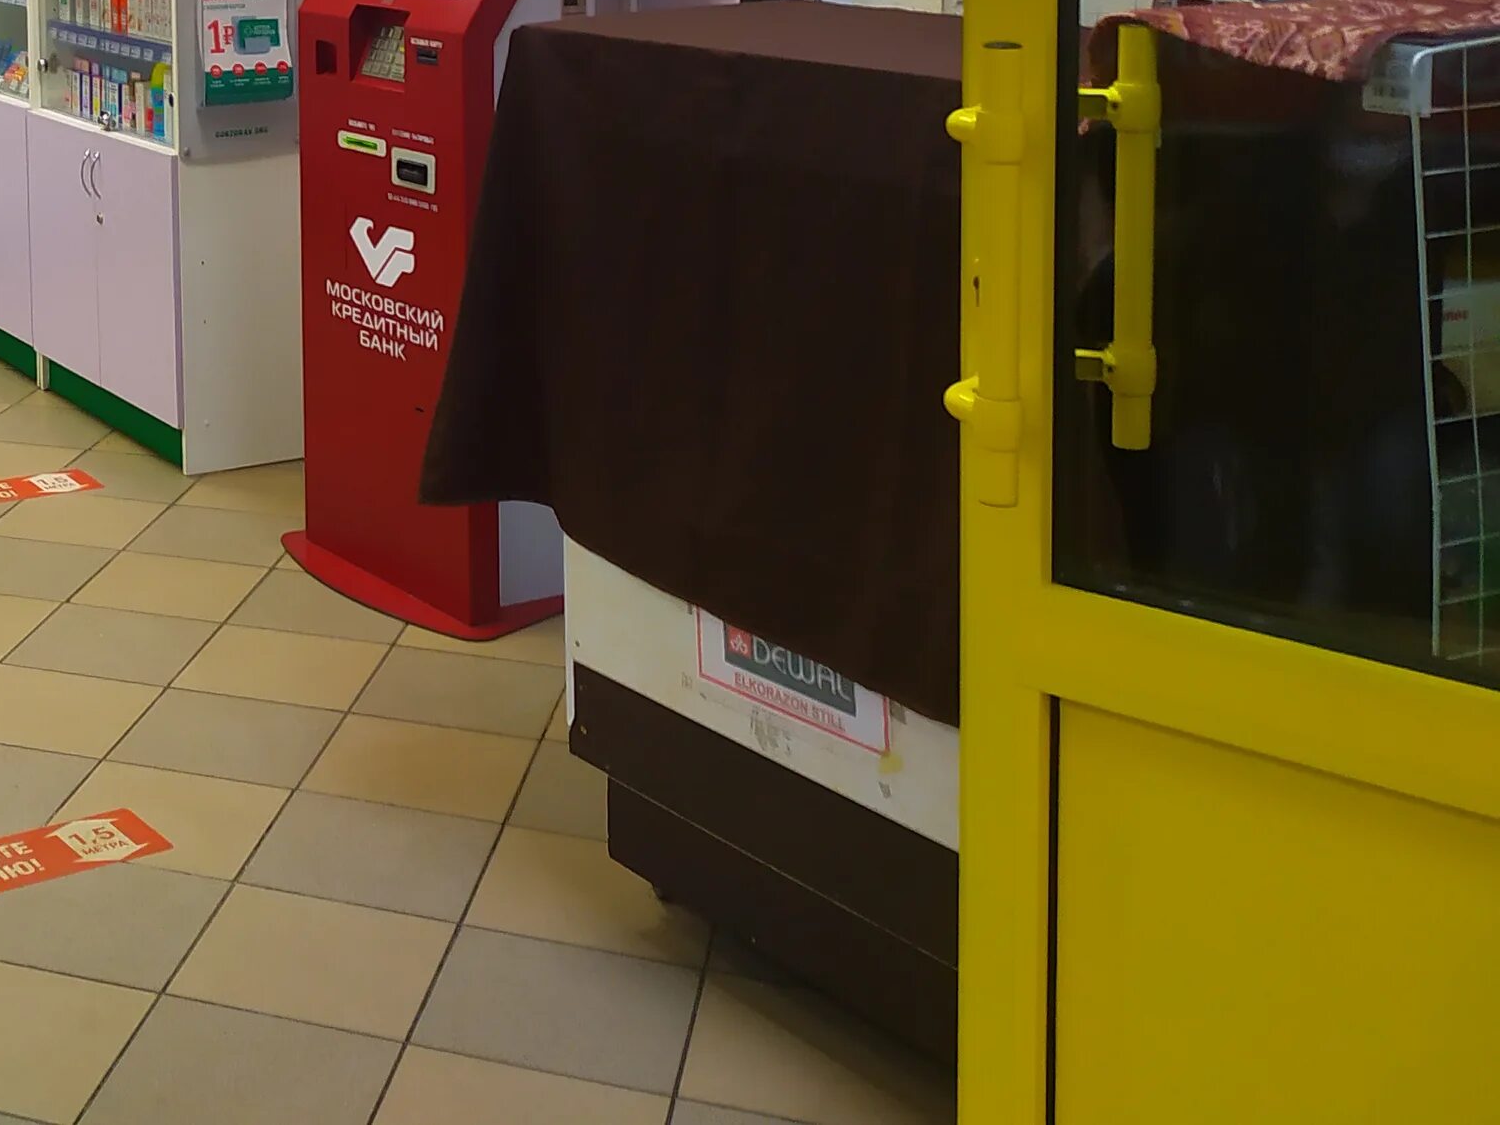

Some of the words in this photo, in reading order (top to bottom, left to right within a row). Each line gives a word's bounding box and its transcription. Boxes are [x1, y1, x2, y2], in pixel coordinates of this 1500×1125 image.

[326, 278, 444, 332] МОСКОВСКИЙ
[331, 300, 438, 351] КРЕДИТНЫЙ
[359, 330, 407, 362] БАНК
[67, 825, 116, 847] 1,5
[80, 839, 131, 856] МЕТРА
